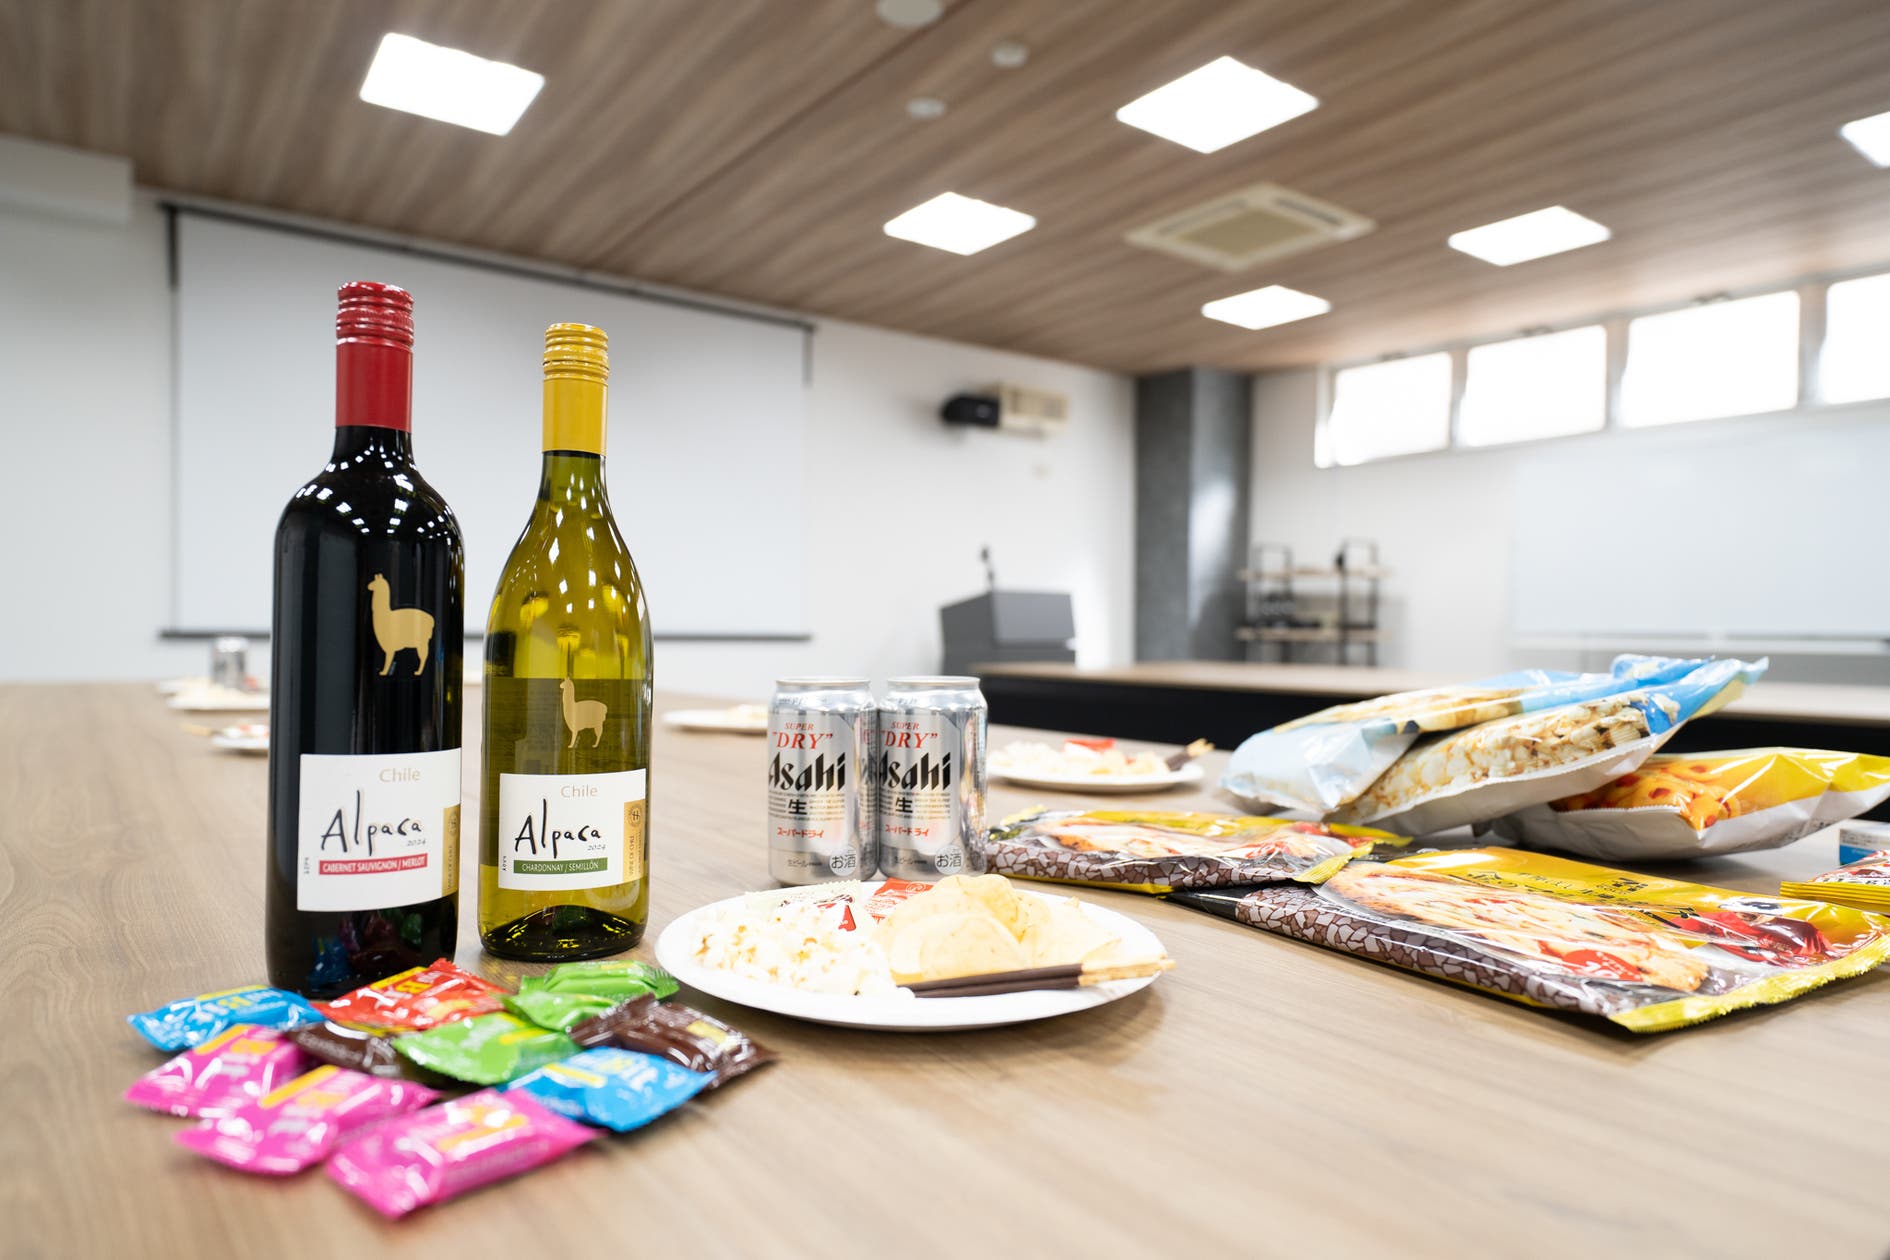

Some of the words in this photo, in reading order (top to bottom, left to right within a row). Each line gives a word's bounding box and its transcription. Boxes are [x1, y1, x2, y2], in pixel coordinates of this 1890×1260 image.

[785, 722, 815, 730] SUPER
[891, 721, 920, 730] SUPER
[379, 768, 422, 783] Chile
[560, 785, 599, 798] Chile
[787, 799, 808, 815] 生
[895, 797, 913, 813] 生
[321, 789, 422, 856] Alpaca
[514, 798, 602, 859] Alpaca
[777, 826, 825, 838] スーパードライ
[322, 862, 357, 873] CABERNET
[357, 860, 398, 872] SAUVIGNON
[402, 856, 426, 868] MERLOT
[521, 863, 564, 872] CHARDONNAY
[831, 853, 857, 869] お酒
[936, 853, 962, 868] お酒
